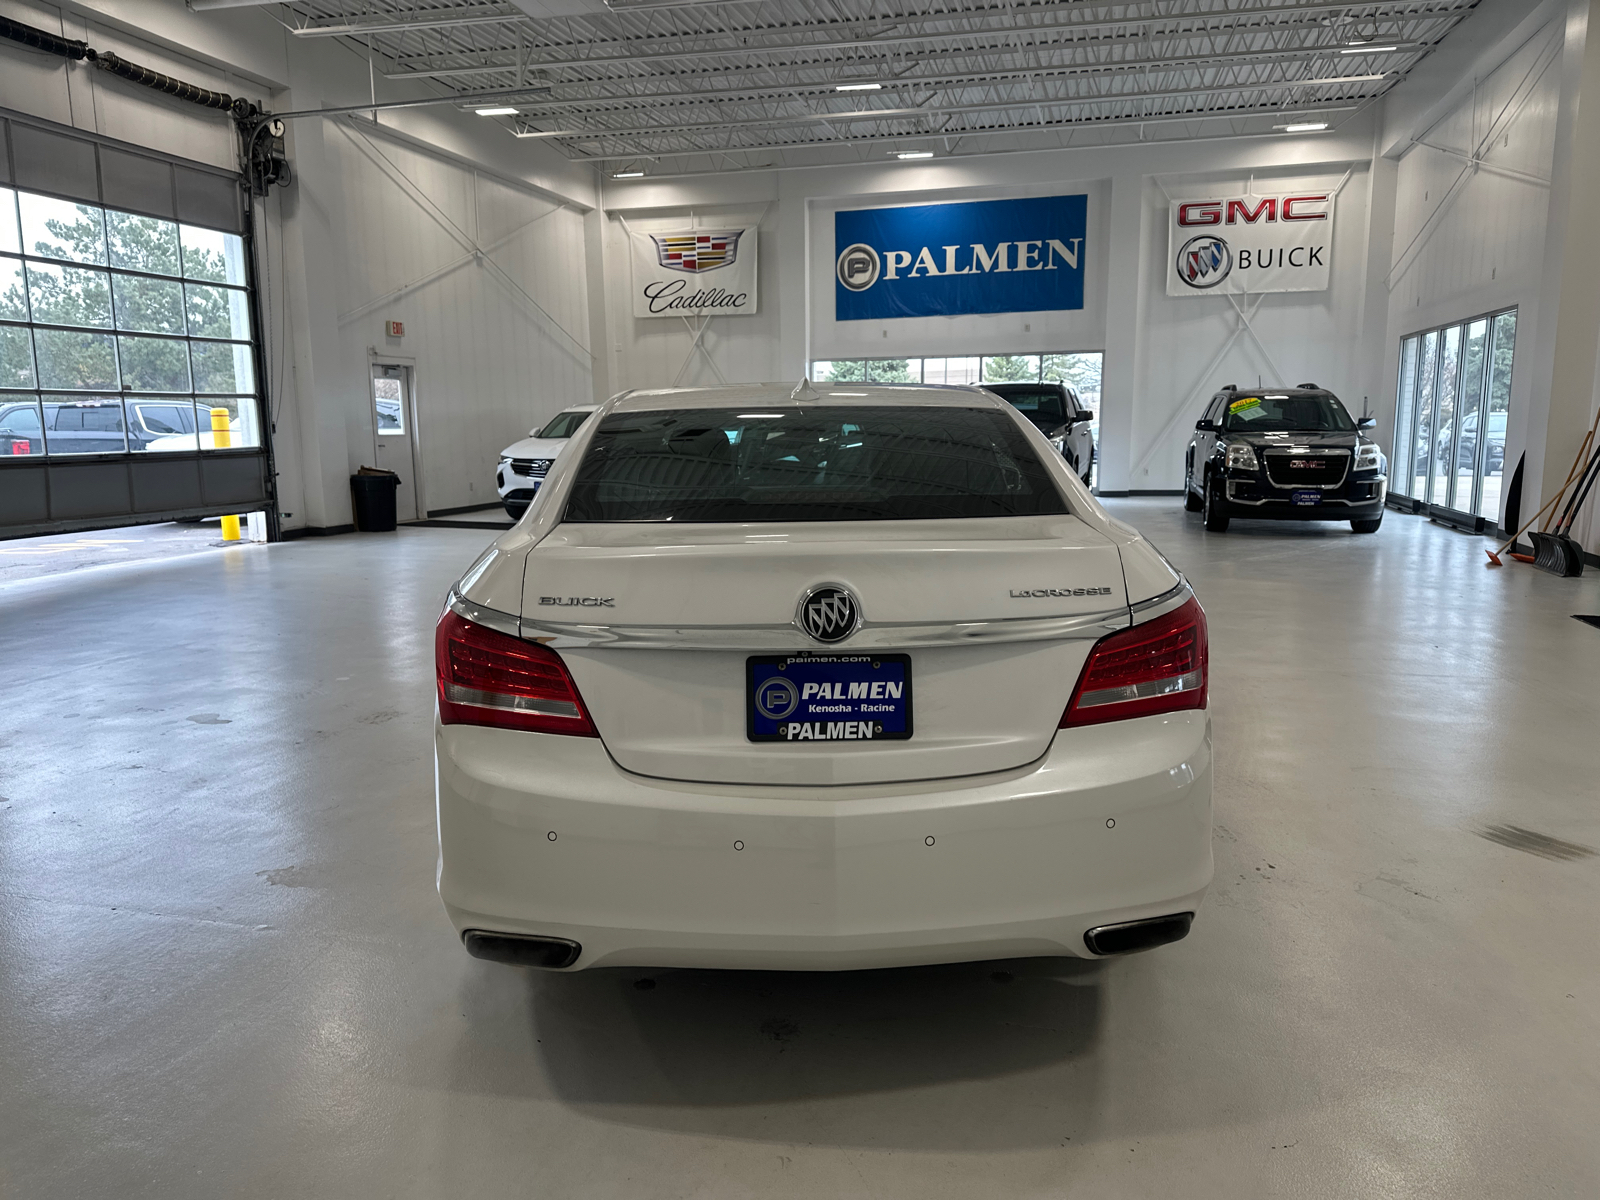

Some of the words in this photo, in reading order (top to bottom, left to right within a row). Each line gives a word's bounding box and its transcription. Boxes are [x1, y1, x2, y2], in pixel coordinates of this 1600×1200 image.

[1177, 194, 1329, 228] GMC
[882, 238, 1084, 280] PALMEN
[1238, 246, 1324, 270] BUICK
[643, 279, 747, 314] Cadillac
[1290, 460, 1325, 468] GMC
[538, 596, 616, 608] BUICK
[787, 656, 871, 665] palmen.com
[801, 681, 904, 700] PALMEN
[808, 704, 852, 713] Kenosha
[860, 703, 896, 712] Racine
[787, 721, 874, 740] PALMEN
